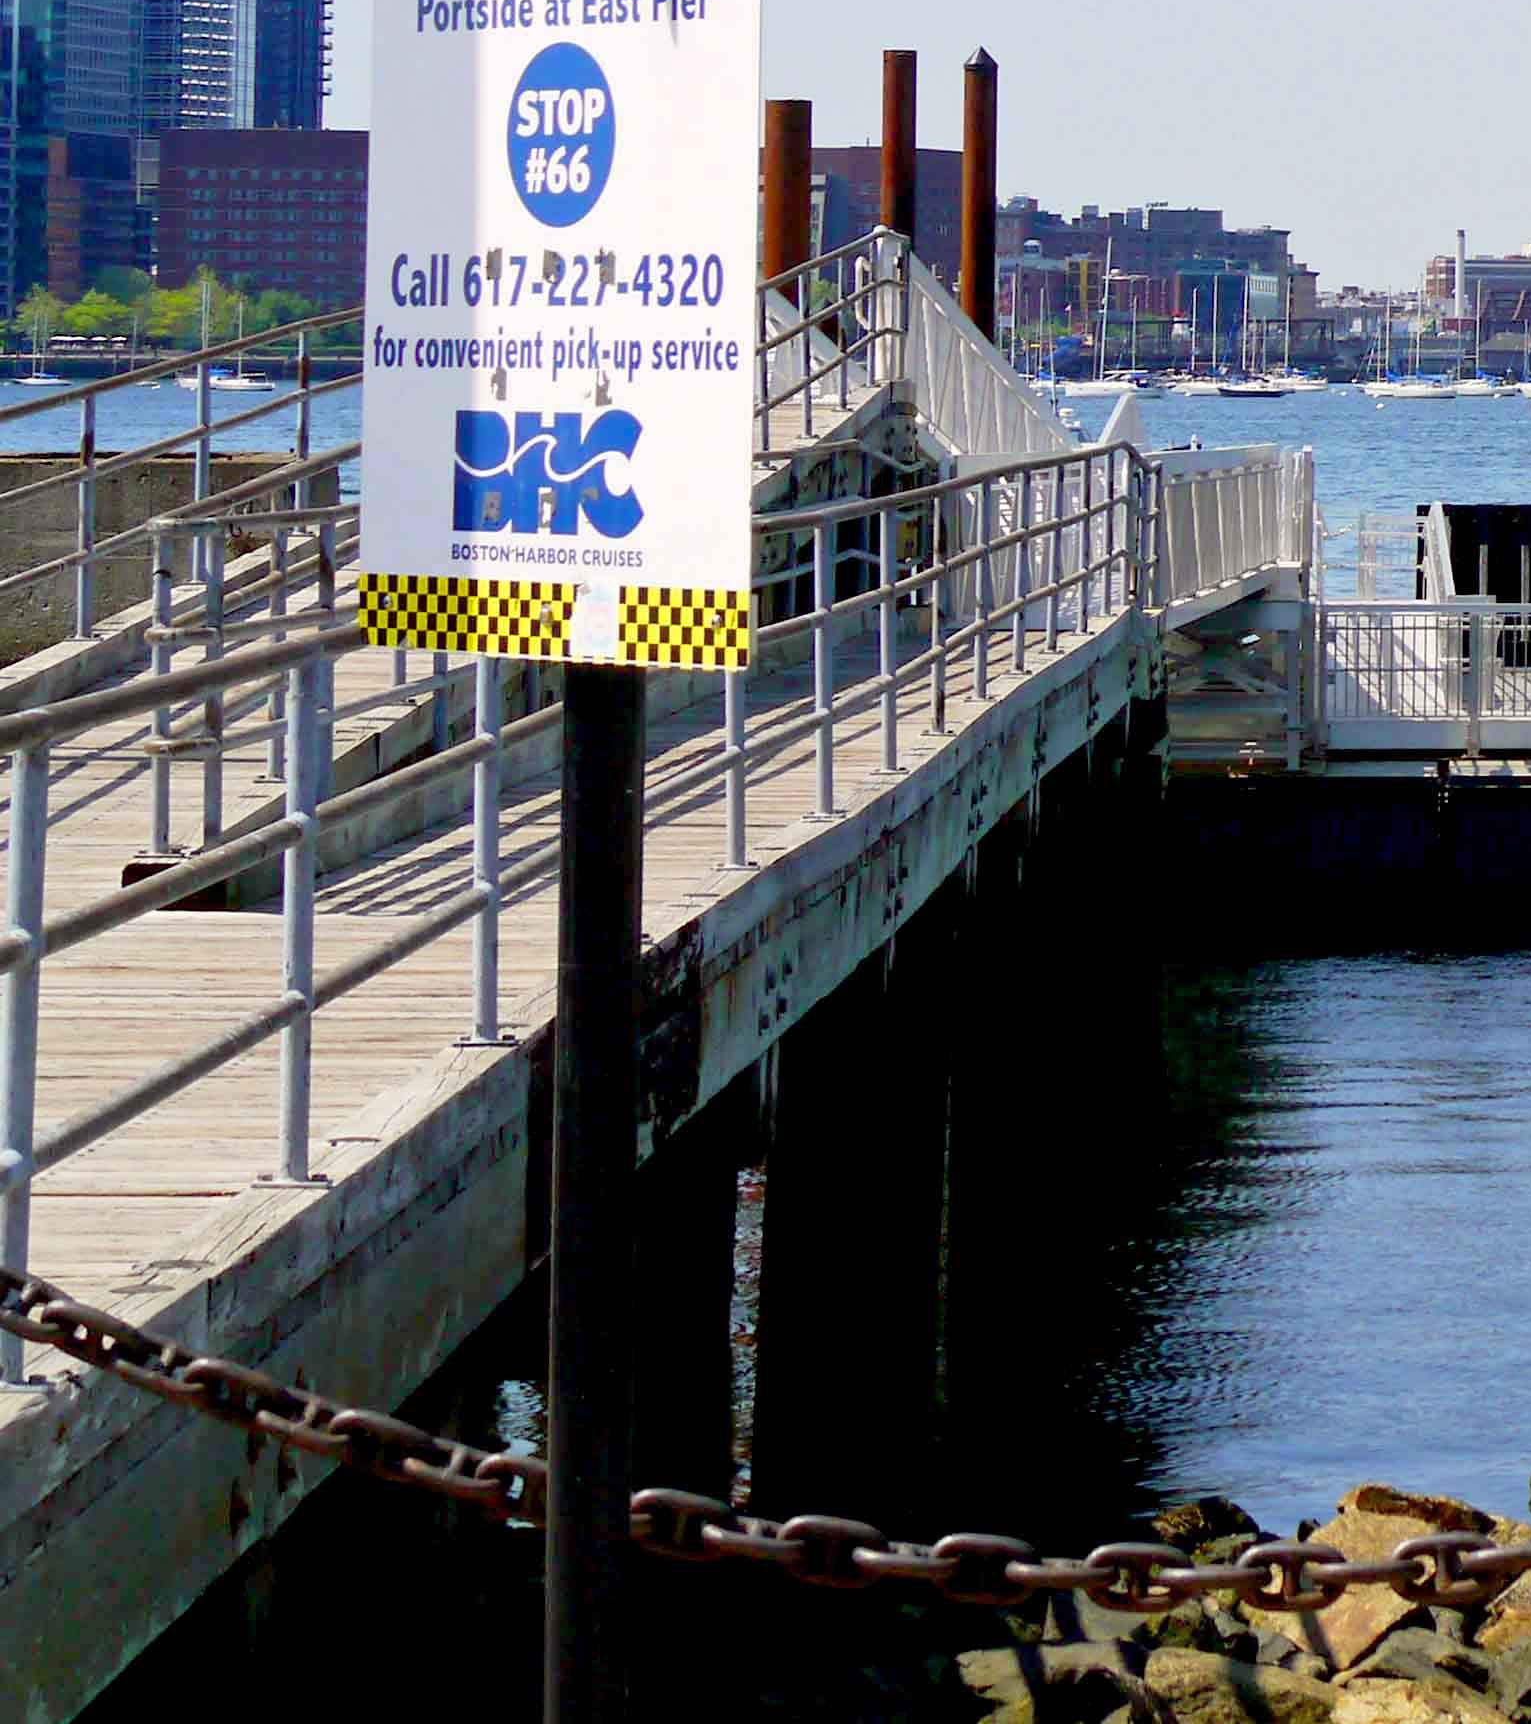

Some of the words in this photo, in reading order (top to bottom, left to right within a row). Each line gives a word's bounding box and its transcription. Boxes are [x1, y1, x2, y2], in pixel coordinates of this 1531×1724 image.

[515, 87, 606, 138] STOP
[524, 145, 592, 194] #66
[391, 253, 450, 308] Call
[463, 253, 724, 308] 617-227-4320
[373, 325, 408, 368] for
[414, 326, 542, 371] convenient
[552, 327, 642, 382] pick-up
[651, 327, 739, 371] service
[450, 543, 511, 561] BOSTON
[515, 547, 577, 565] HARBOR
[582, 549, 644, 568] CRUISES
